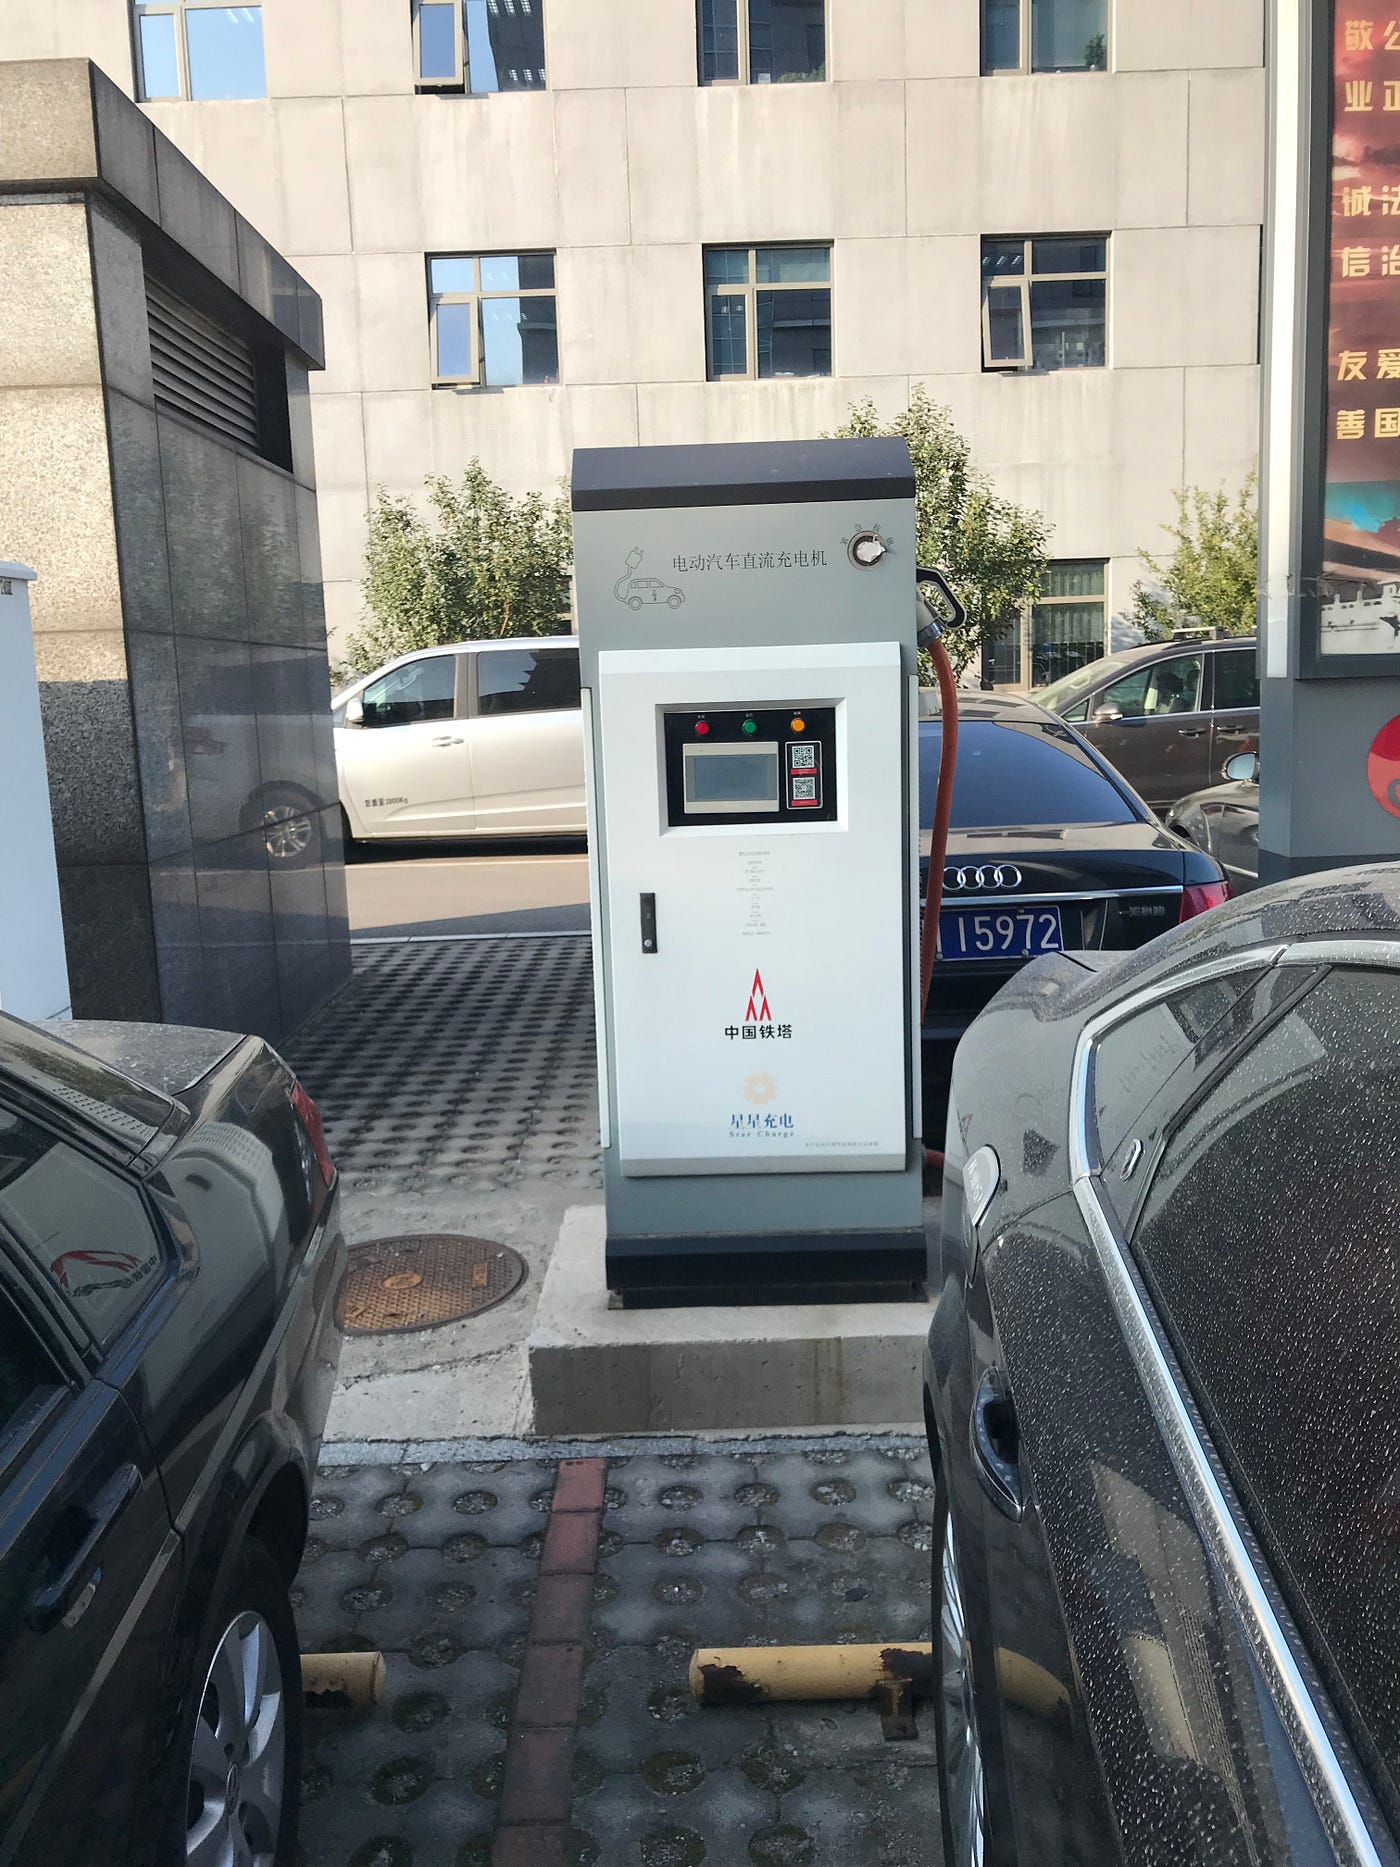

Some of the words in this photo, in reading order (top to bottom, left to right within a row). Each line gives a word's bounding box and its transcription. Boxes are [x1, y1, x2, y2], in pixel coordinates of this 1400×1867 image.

[672, 549, 827, 572] 电动汽车直流充电机
[724, 1024, 793, 1040] 中国铁塔
[729, 1113, 794, 1130] 星星充电
[729, 1130, 751, 1138] Star
[757, 1130, 795, 1139] Charge
